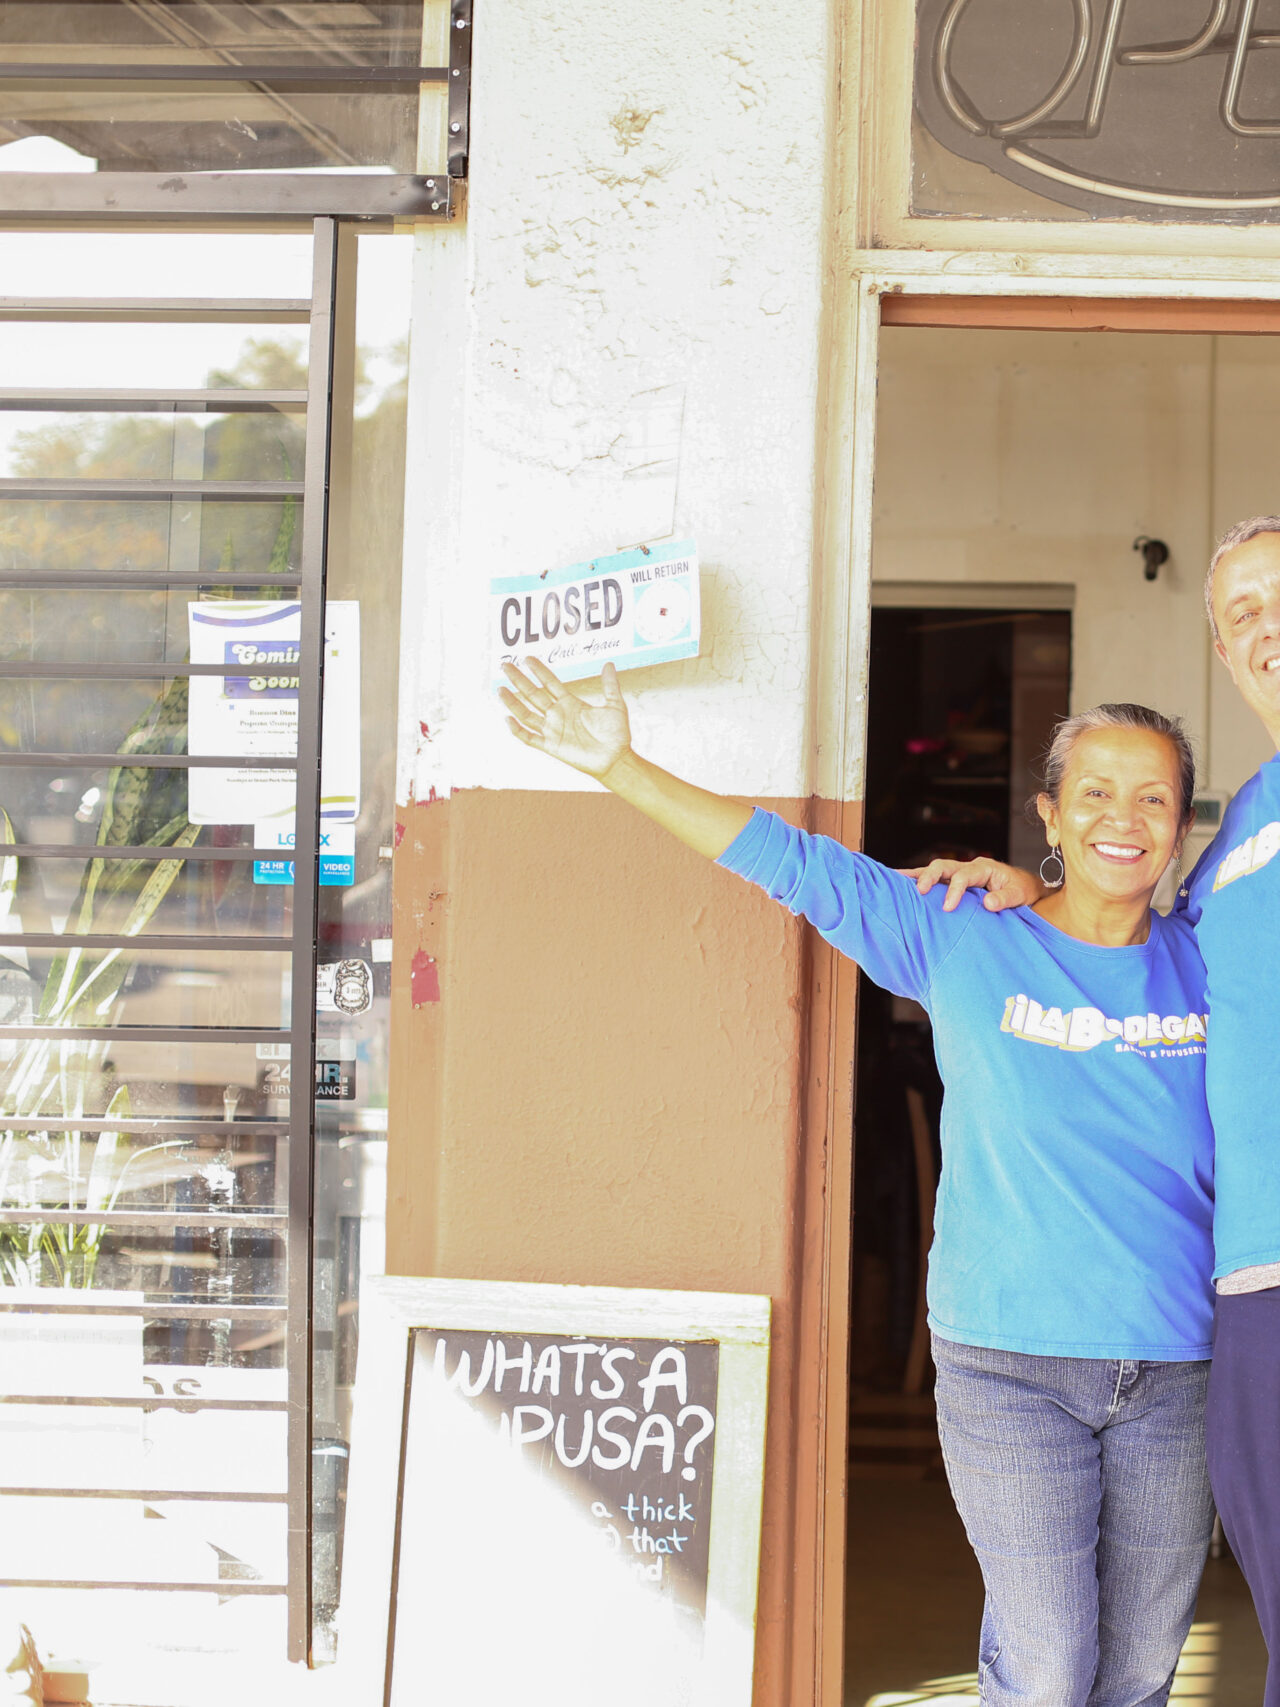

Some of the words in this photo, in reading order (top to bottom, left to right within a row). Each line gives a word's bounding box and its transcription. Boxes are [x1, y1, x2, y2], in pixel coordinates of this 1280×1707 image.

[630, 569, 652, 584] WILL
[654, 561, 690, 578] RETURN
[500, 577, 623, 647] CLOSED
[231, 643, 300, 665] Comi
[278, 832, 330, 847] LOX
[260, 861, 270, 870] 24
[272, 862, 285, 870] HR
[323, 863, 351, 871] VIDEO
[263, 1085, 349, 1096] SURANCE
[434, 1338, 635, 1400] WHAT'S
[637, 1346, 688, 1413] A
[500, 1404, 715, 1481] PUSA?
[621, 1493, 696, 1523] thick
[626, 1526, 689, 1554] that
